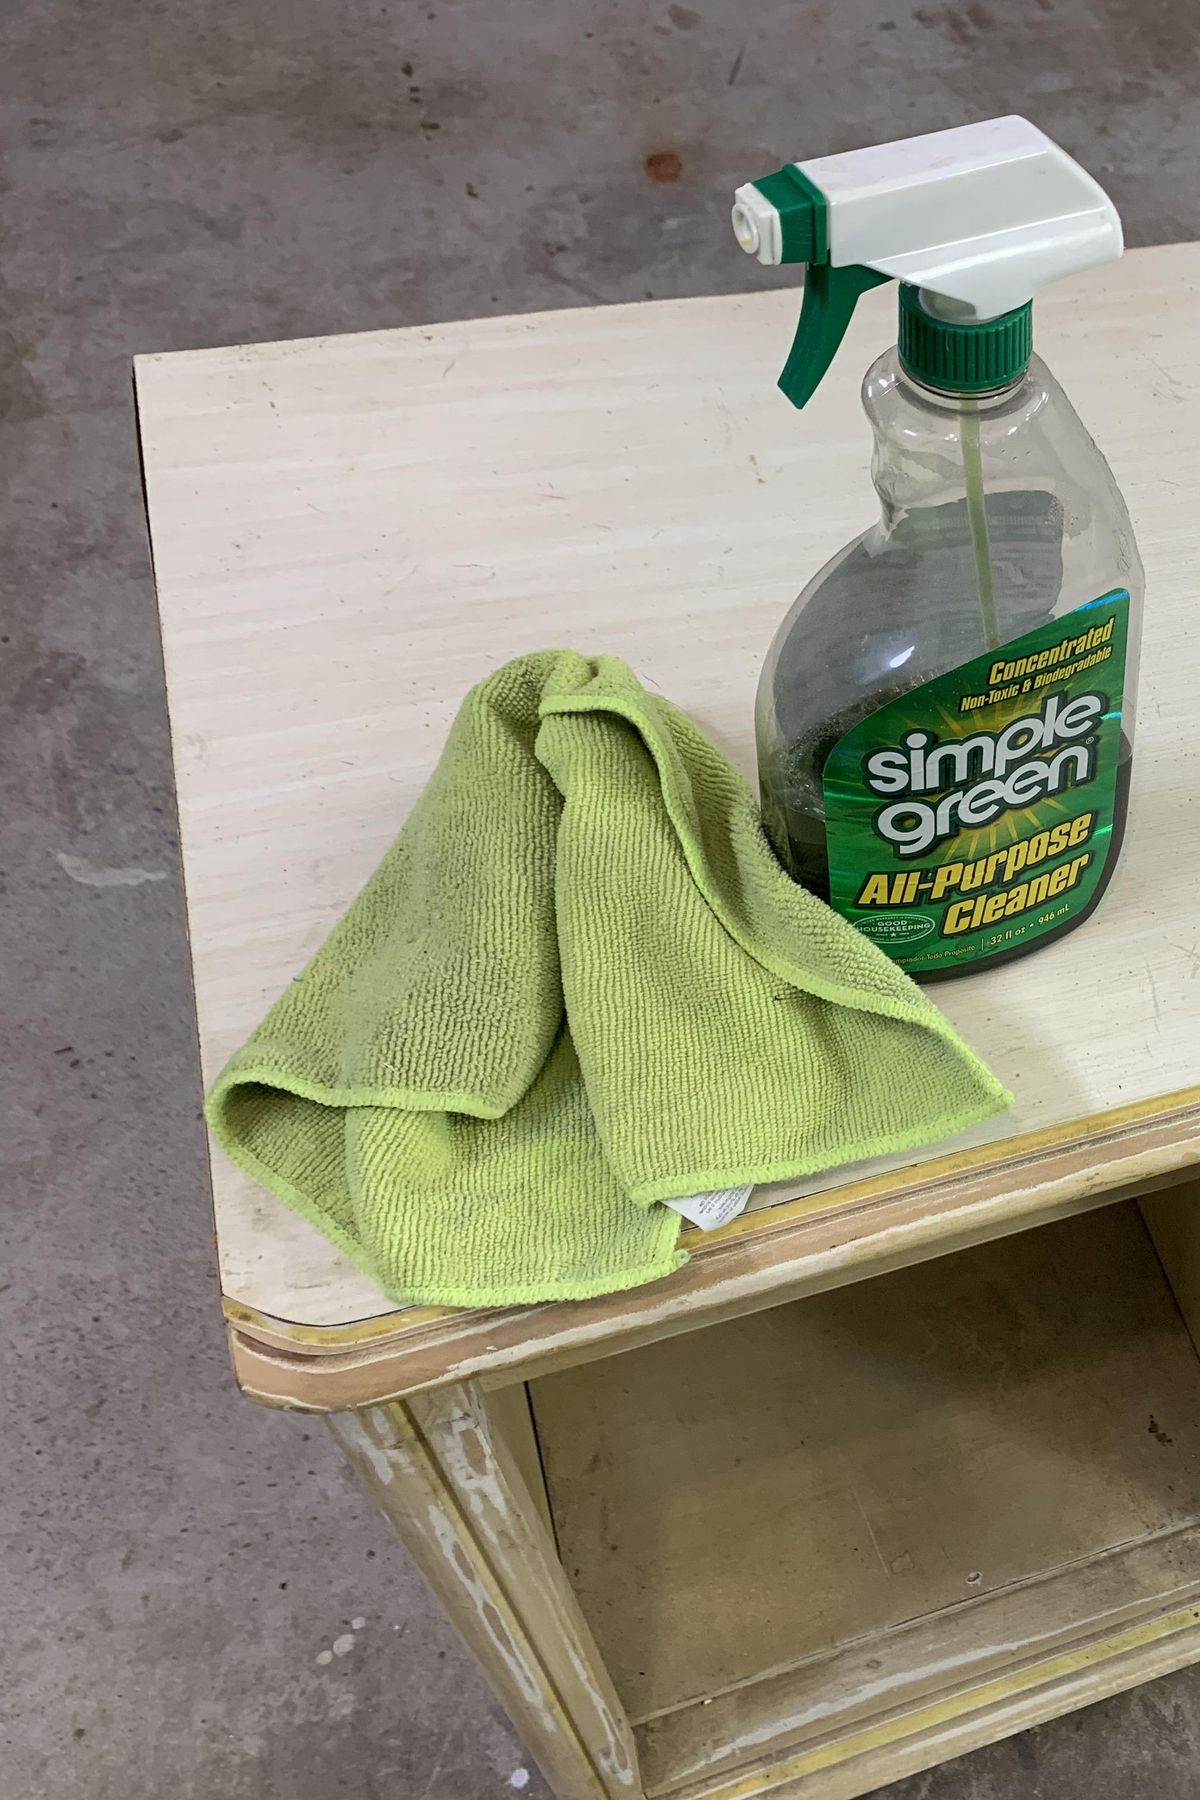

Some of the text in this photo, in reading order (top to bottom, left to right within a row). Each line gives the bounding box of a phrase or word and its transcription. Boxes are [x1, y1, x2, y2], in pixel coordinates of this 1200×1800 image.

[960, 646, 1112, 712] Non-Toxic & Biodegradable
[989, 617, 1115, 685] Concentrated
[867, 695, 1102, 793] simple
[877, 745, 1089, 855] green
[857, 813, 1093, 905] All-Purpose
[943, 853, 1090, 935] Cleaner
[990, 903, 1070, 945] 32 fl oz 946 mL
